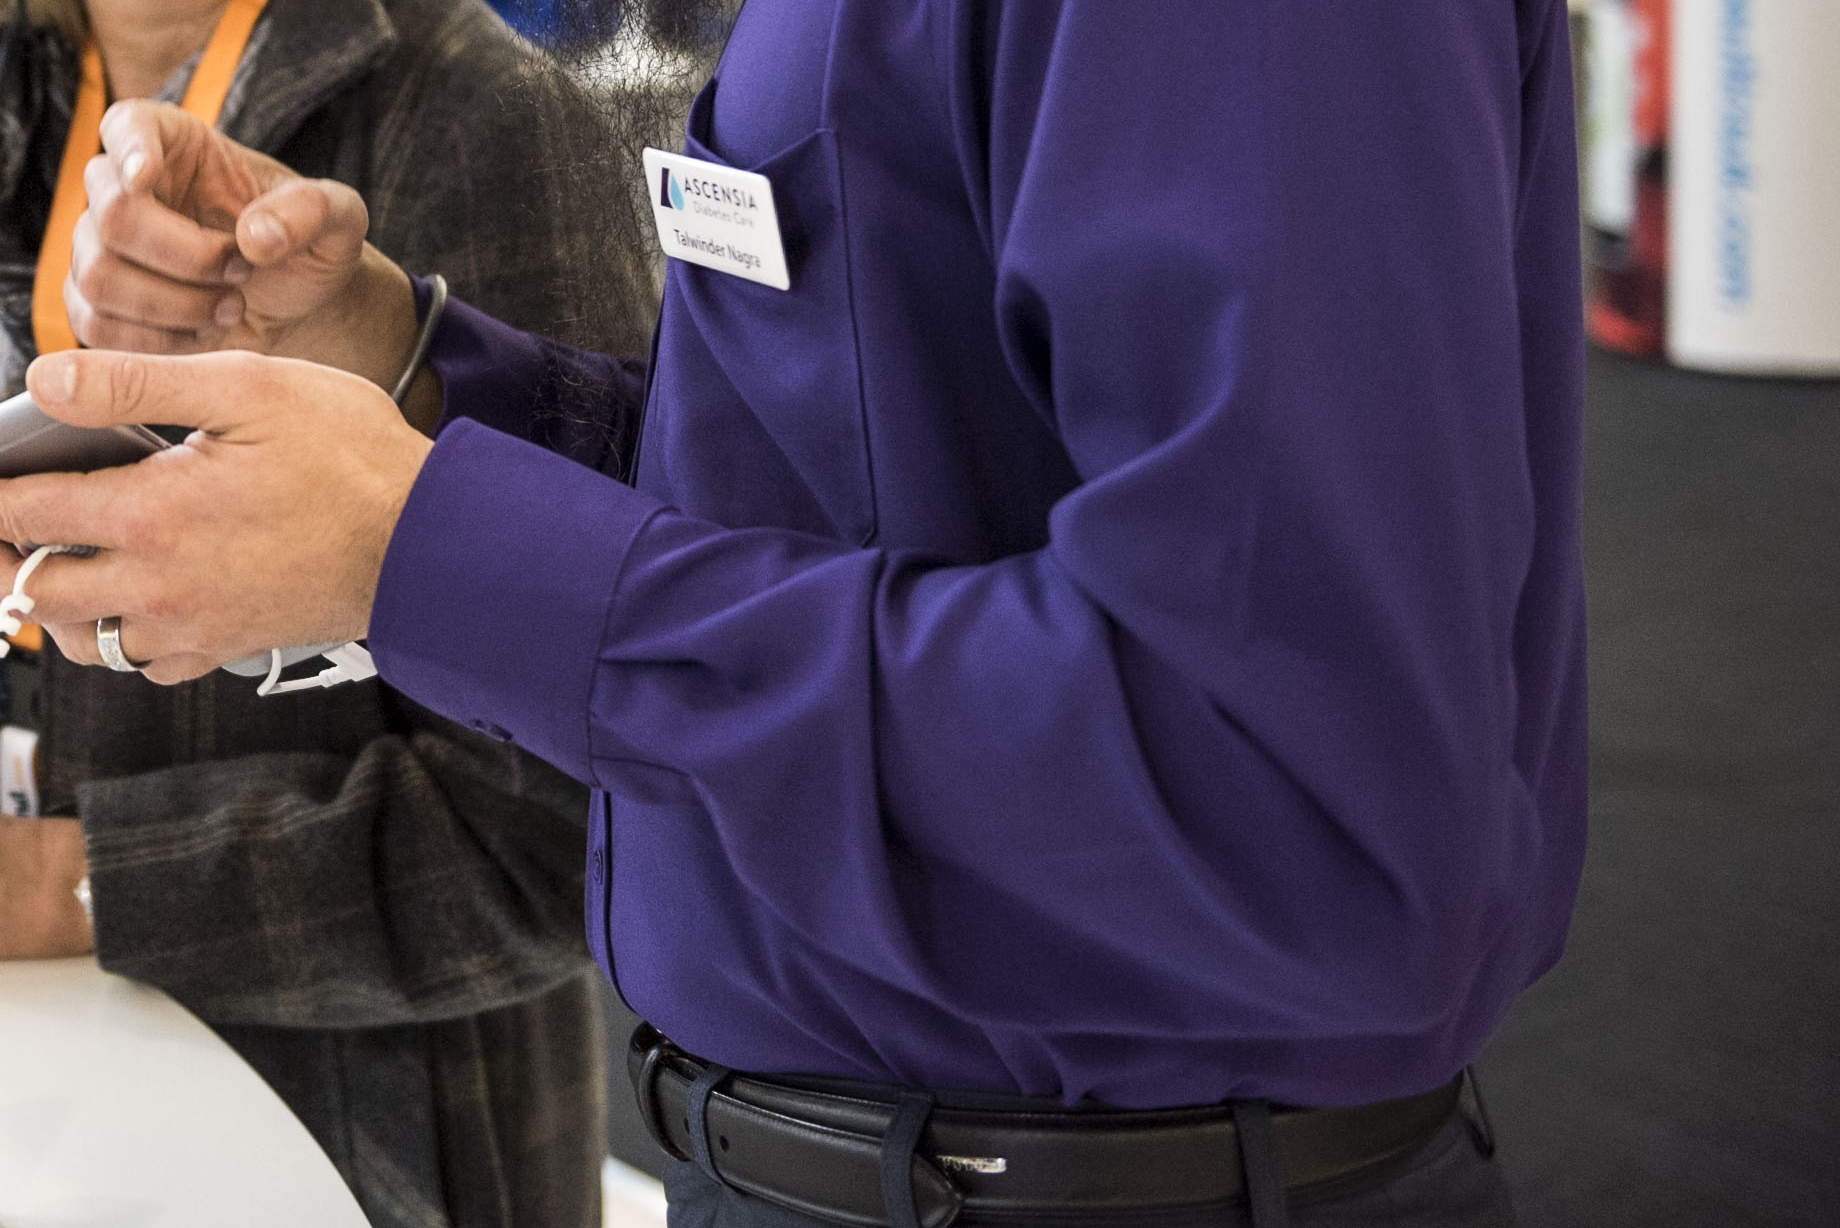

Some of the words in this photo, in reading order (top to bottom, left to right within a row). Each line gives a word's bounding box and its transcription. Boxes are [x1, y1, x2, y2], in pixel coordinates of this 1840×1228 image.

[684, 177, 759, 211] ASCENSIA
[692, 201, 732, 223] Diabetes
[734, 211, 756, 228] Care
[673, 228, 725, 258] Talwinder
[727, 244, 762, 269] Nagra
